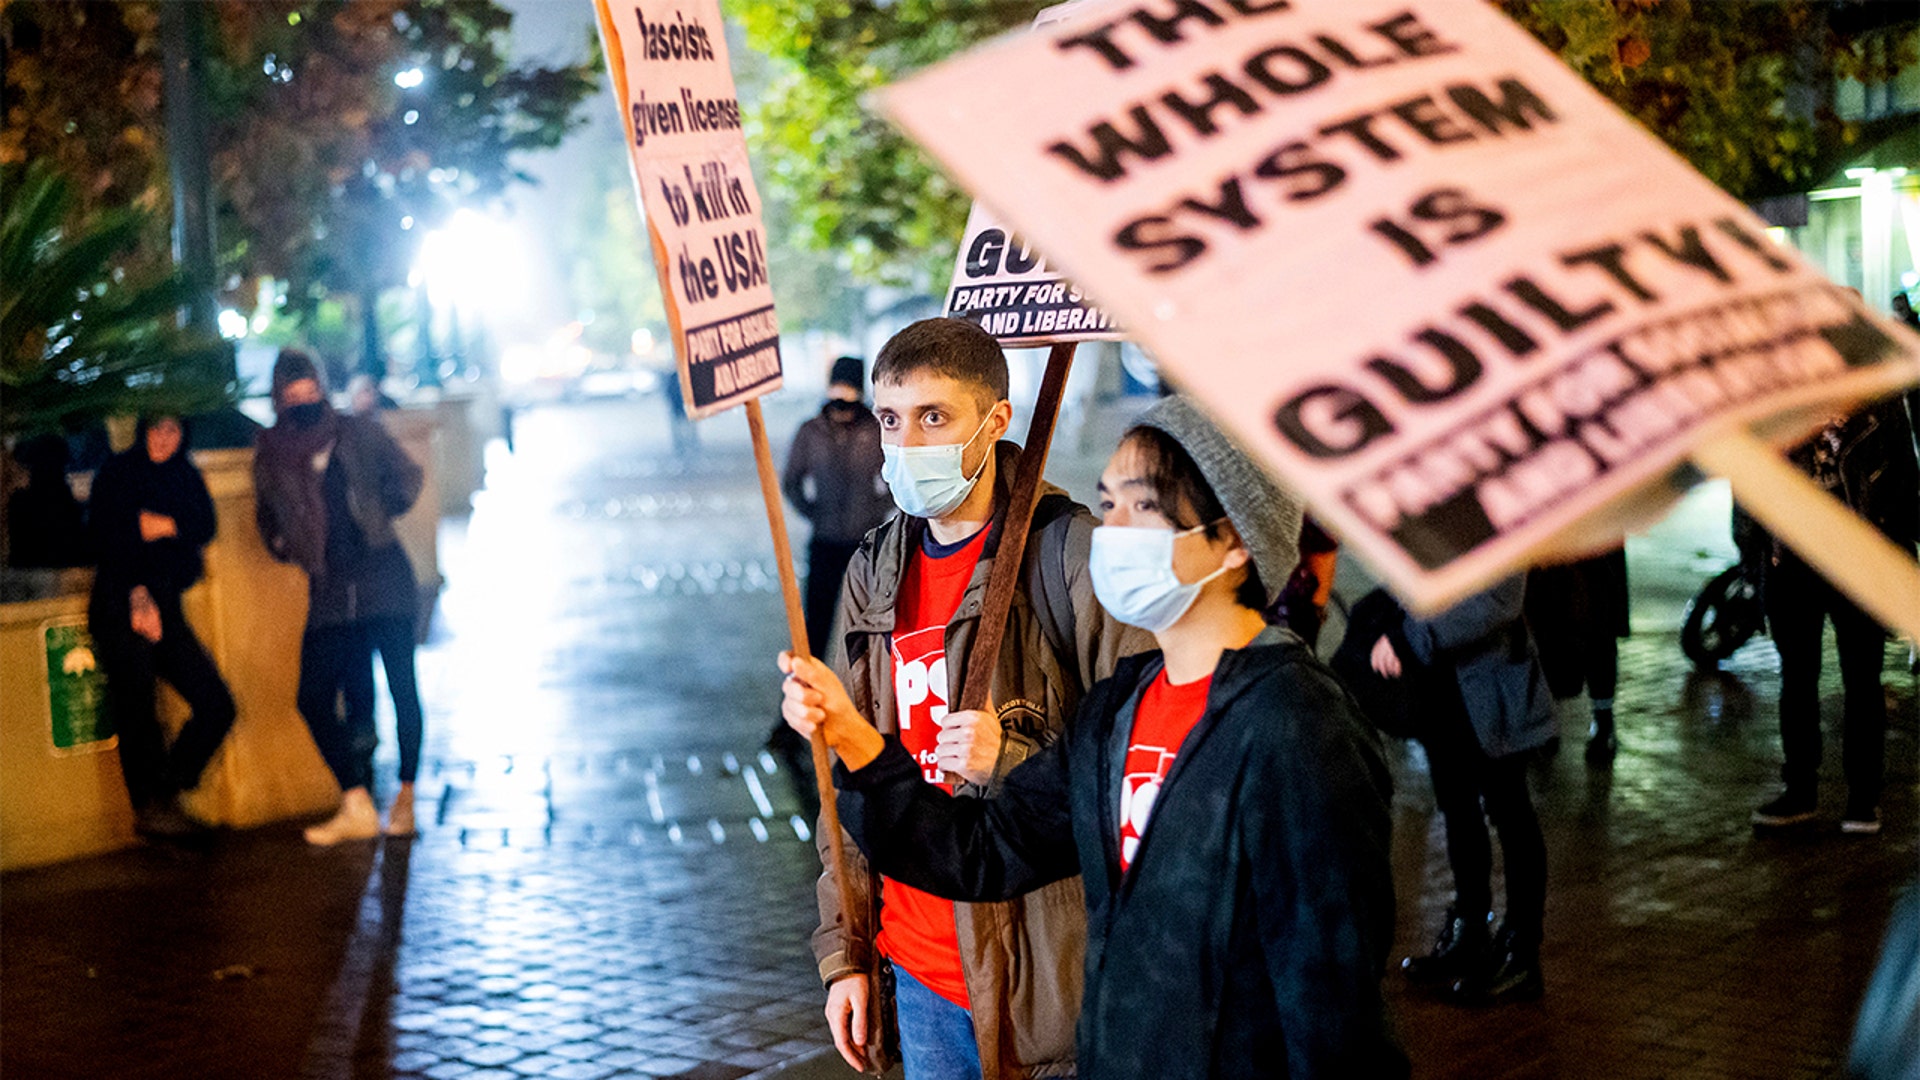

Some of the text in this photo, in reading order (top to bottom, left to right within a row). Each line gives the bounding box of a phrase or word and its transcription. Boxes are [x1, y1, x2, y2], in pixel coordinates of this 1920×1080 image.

[635, 7, 715, 61] fascists
[632, 86, 743, 147] given license
[1048, 11, 1460, 183] WHOLE
[661, 160, 752, 227] to kill in
[1115, 76, 1560, 273] SYSTEM
[1371, 188, 1505, 267] IS
[678, 228, 767, 304] the USA!
[953, 285, 1024, 311] PARTY
[1022, 283, 1066, 305] FOR
[980, 310, 1020, 335] AND
[1273, 217, 1791, 459] GUILTY!
